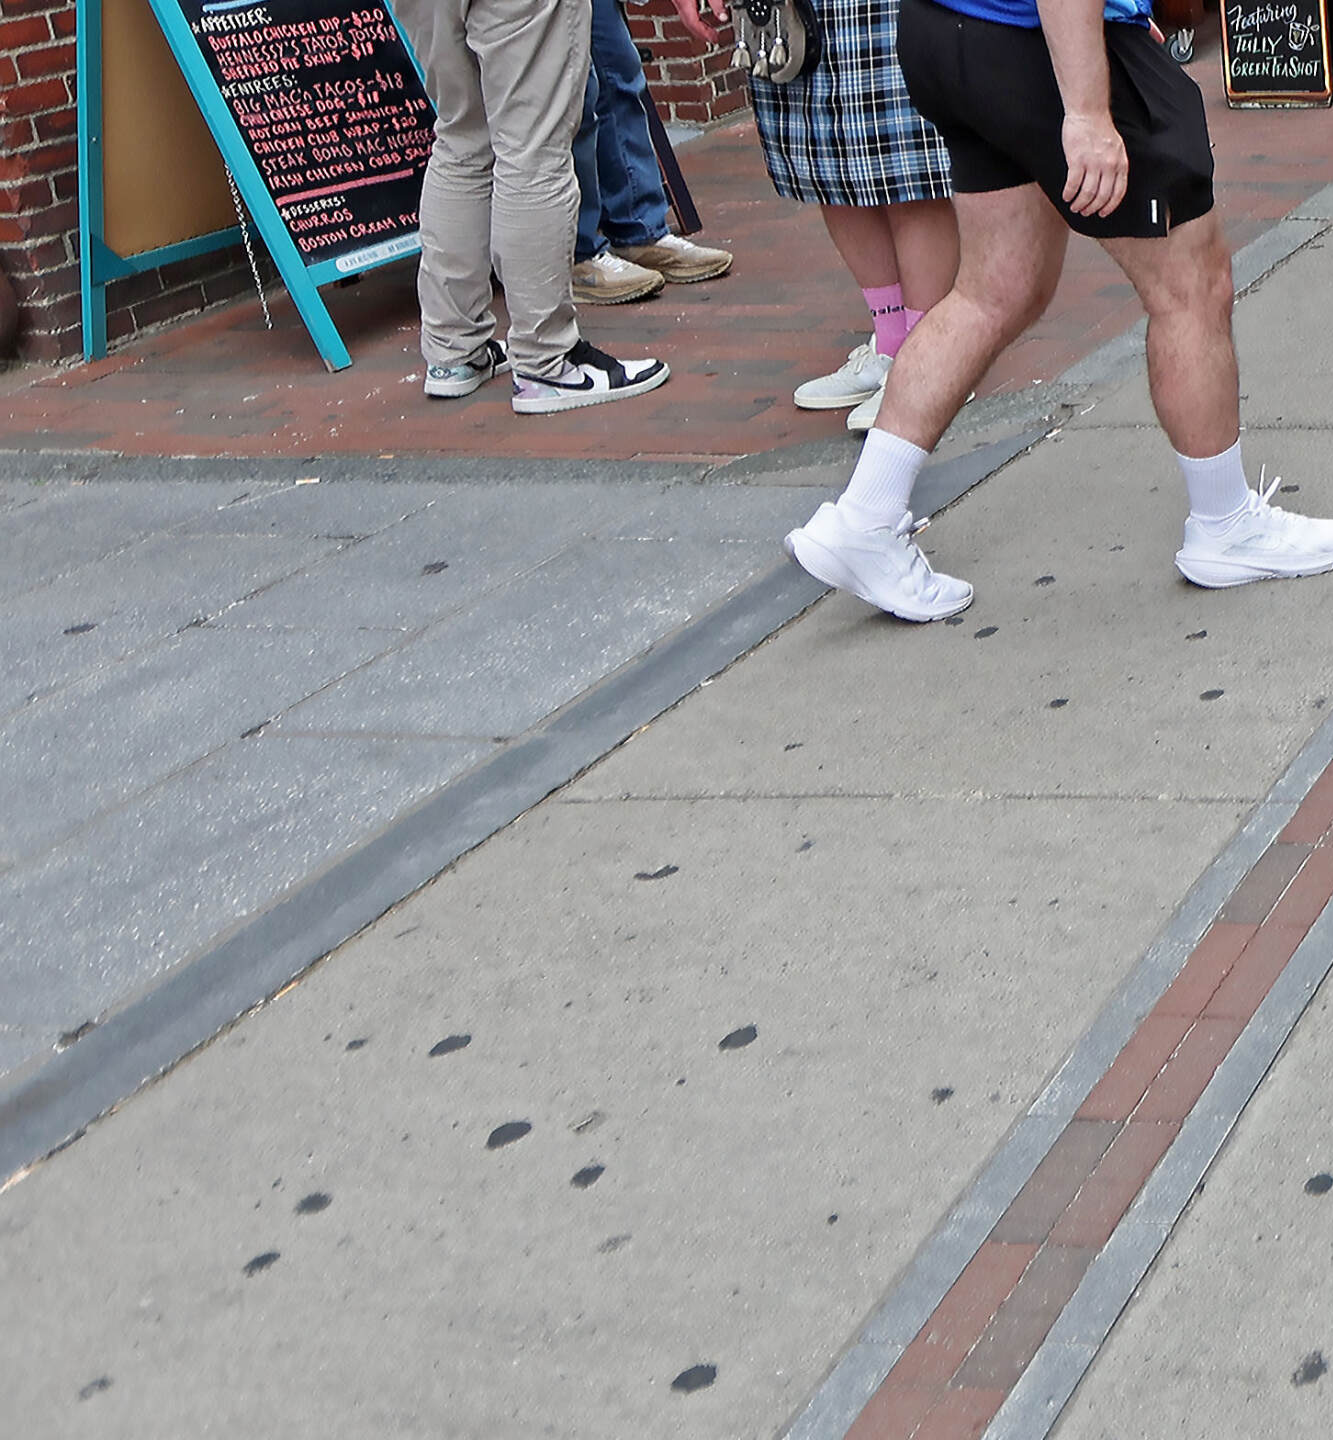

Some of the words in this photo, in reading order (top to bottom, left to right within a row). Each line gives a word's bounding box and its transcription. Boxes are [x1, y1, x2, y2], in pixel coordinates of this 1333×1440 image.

[201, 6, 273, 33] APPETIZER:
[207, 29, 264, 53] BUFFALO
[263, 21, 317, 42] CHICKEN
[319, 17, 341, 33] DIP
[215, 38, 300, 68] HENNESSY'S
[301, 32, 345, 55] TATOR
[303, 50, 341, 68] SKINS
[1288, 55, 1321, 78] SHOT
[232, 95, 261, 116] BIG
[313, 77, 366, 101] TACOS
[315, 96, 346, 113] DOG
[248, 124, 273, 141] HOT
[272, 121, 302, 136] CORN
[305, 113, 340, 130] BEEF
[253, 136, 305, 155] CHICKEN
[307, 129, 340, 147] CLUB
[342, 121, 381, 139] WRAP
[261, 152, 308, 176] STEAK
[268, 171, 305, 191] IRISH
[305, 160, 365, 182] CHICKEN
[288, 207, 354, 234] CHURROS
[298, 228, 349, 254] BOSTON
[349, 216, 397, 239] CREAM
[399, 211, 419, 227] PIE
